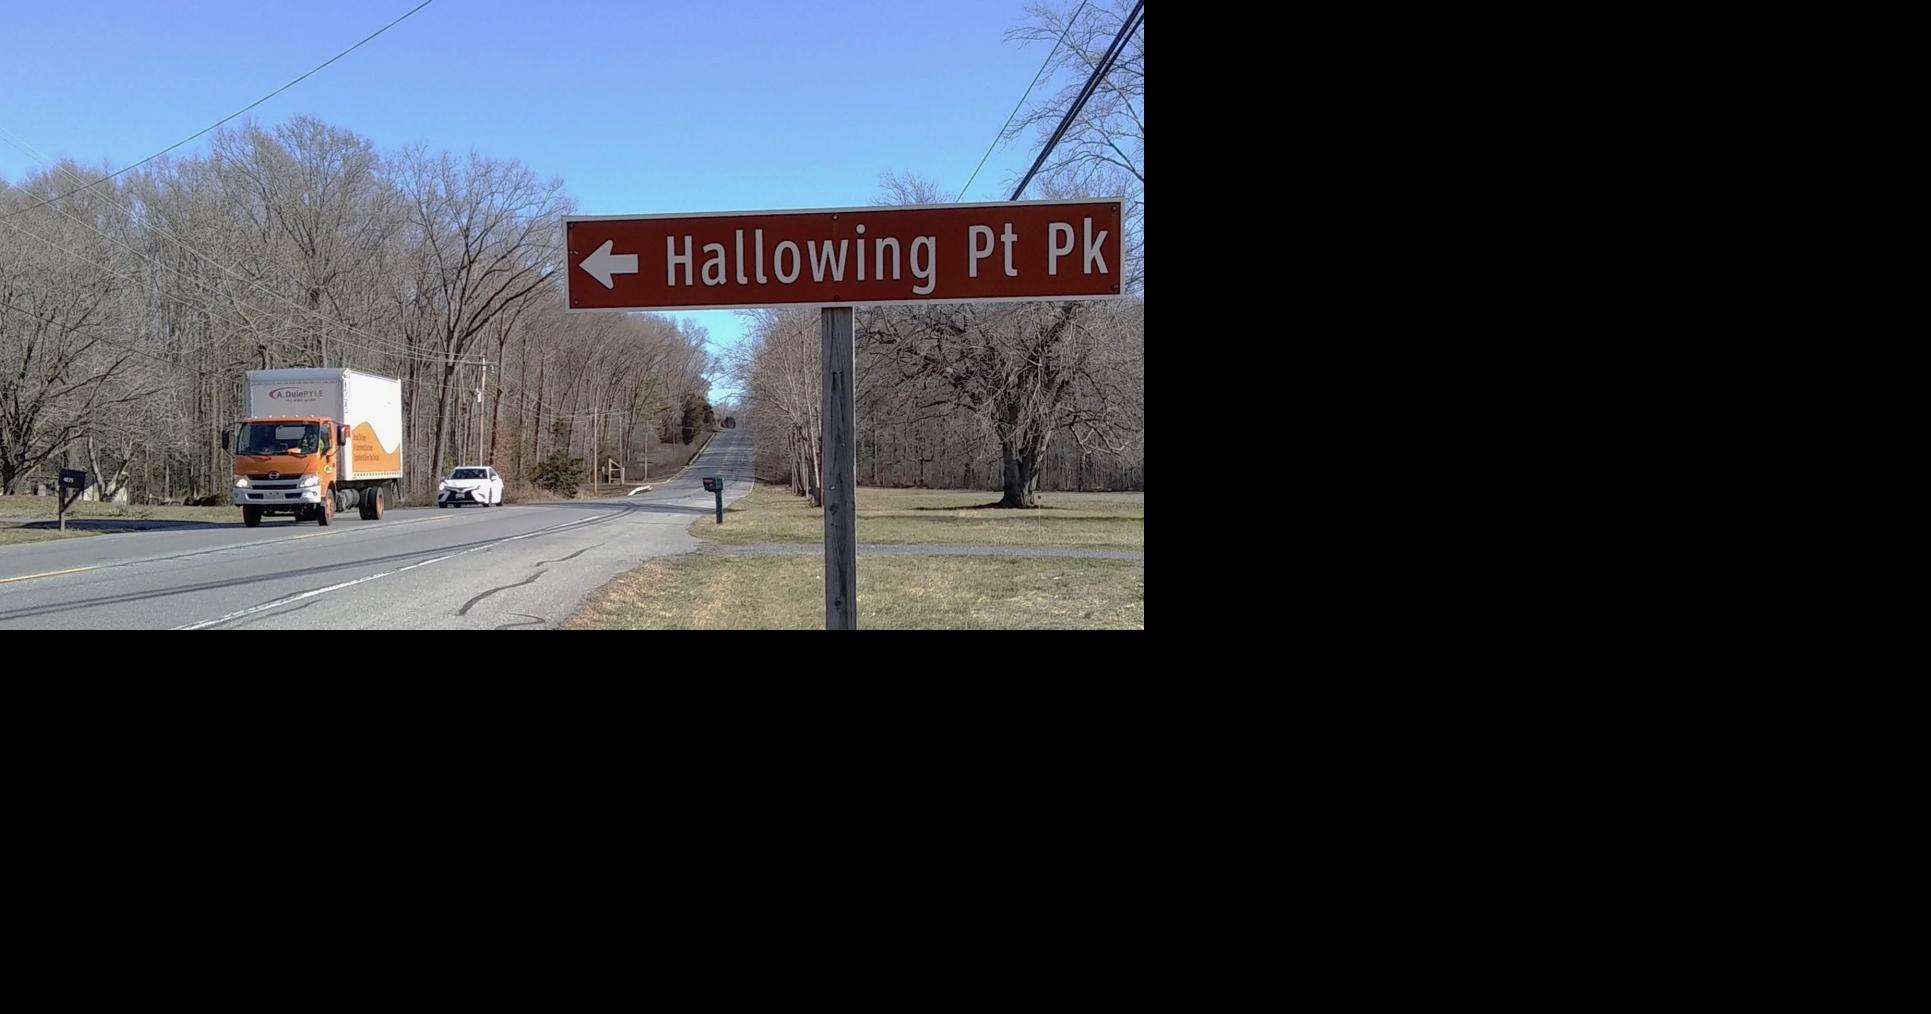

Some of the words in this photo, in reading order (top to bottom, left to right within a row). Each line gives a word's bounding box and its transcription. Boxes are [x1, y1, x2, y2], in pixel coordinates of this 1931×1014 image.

[666, 224, 936, 295] Hallowing
[968, 222, 1018, 278] Pt
[1048, 217, 1109, 275] Pk
